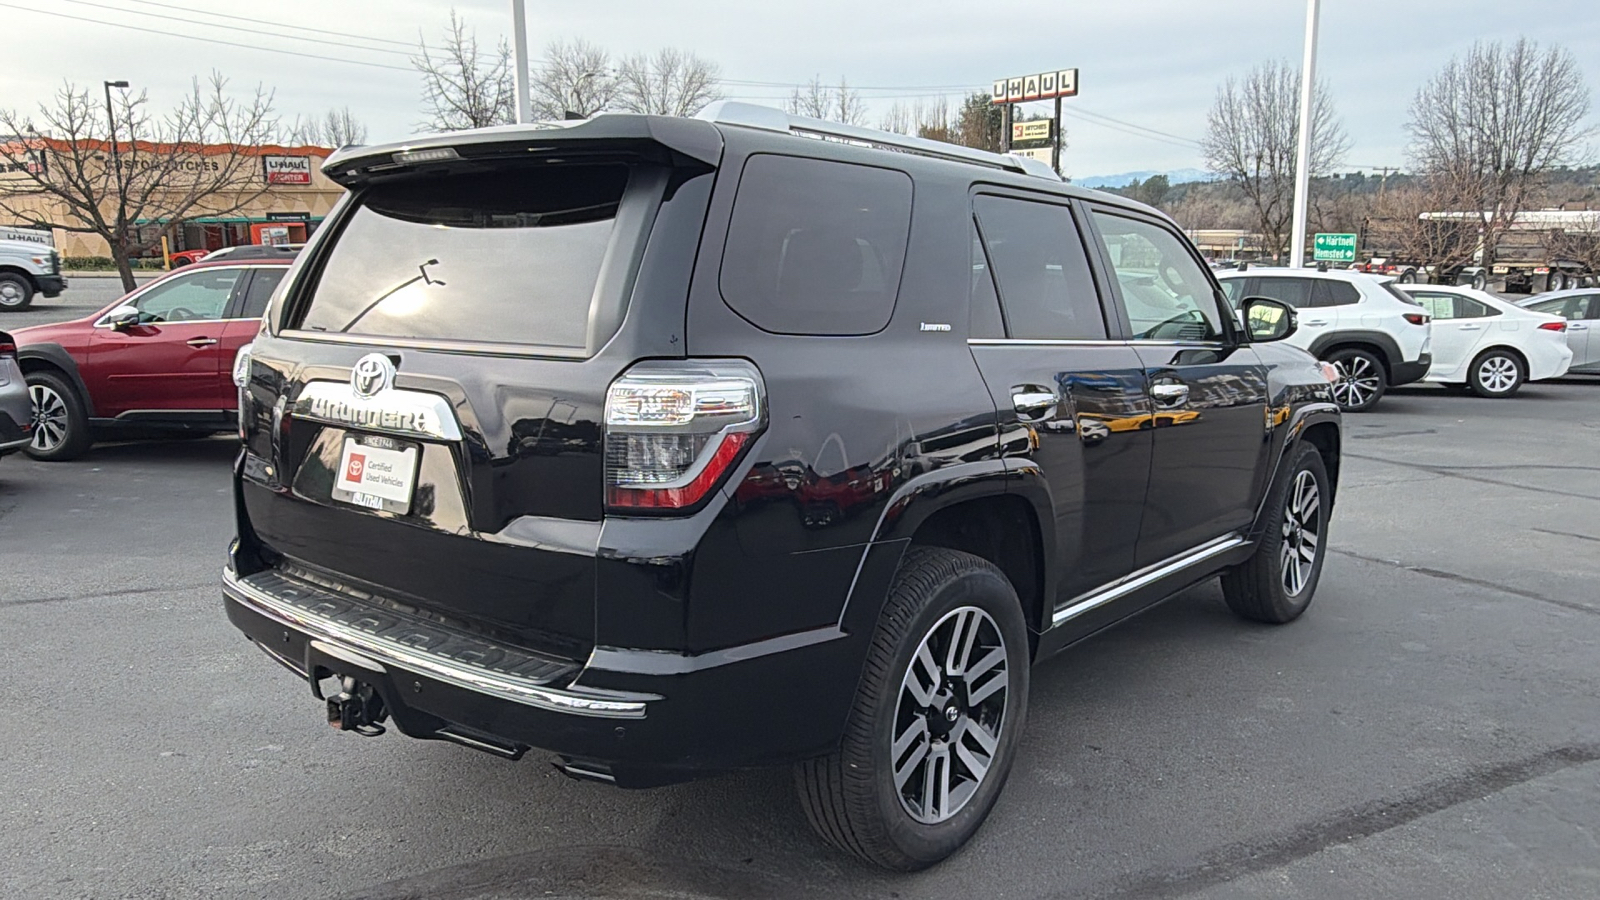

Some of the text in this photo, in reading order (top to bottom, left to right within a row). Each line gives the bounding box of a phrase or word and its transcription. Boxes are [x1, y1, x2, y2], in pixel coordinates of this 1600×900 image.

[1326, 236, 1354, 246] Hartnell
[1315, 248, 1344, 258] Hemsted
[364, 437, 379, 446] SINCE
[368, 461, 393, 472] Certified
[366, 473, 404, 487] Used Vehicles
